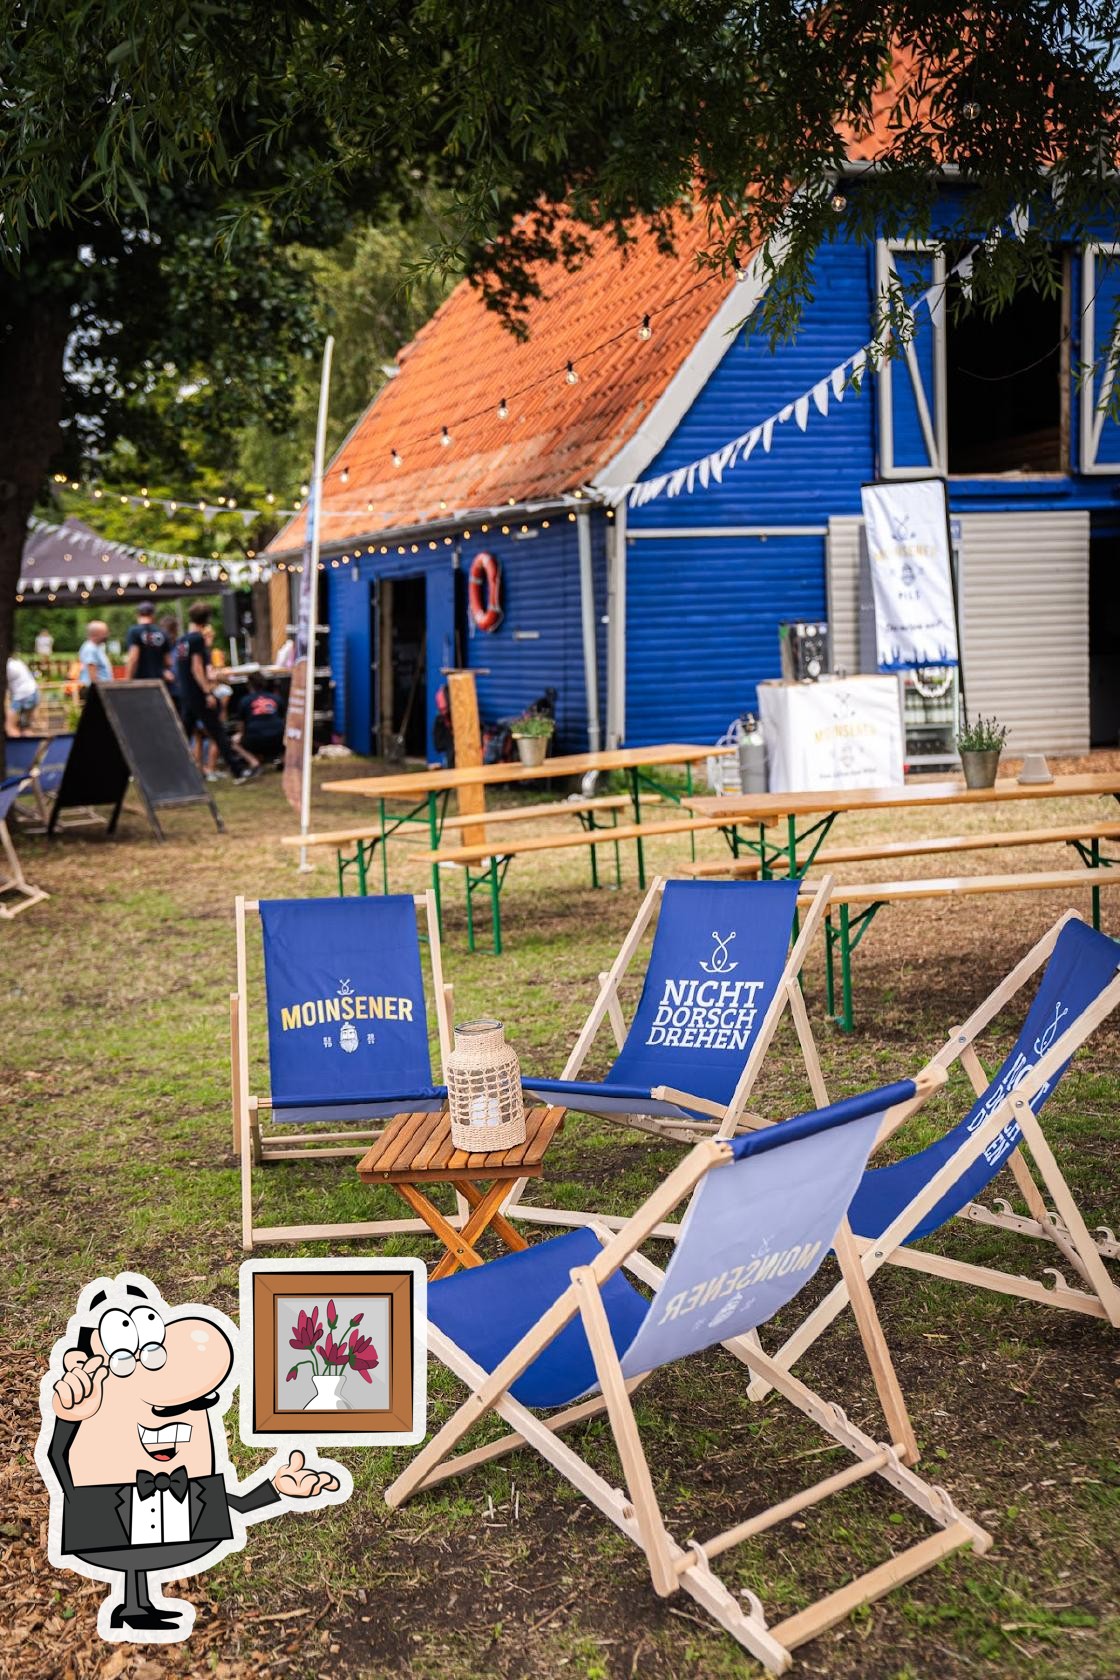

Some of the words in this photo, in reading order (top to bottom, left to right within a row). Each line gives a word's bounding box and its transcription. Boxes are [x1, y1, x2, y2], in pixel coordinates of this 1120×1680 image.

[660, 979, 764, 1008] NICHT
[281, 996, 413, 1031] MOINSENER
[652, 1005, 758, 1029] DORSCH
[645, 1026, 751, 1050] DREHEN
